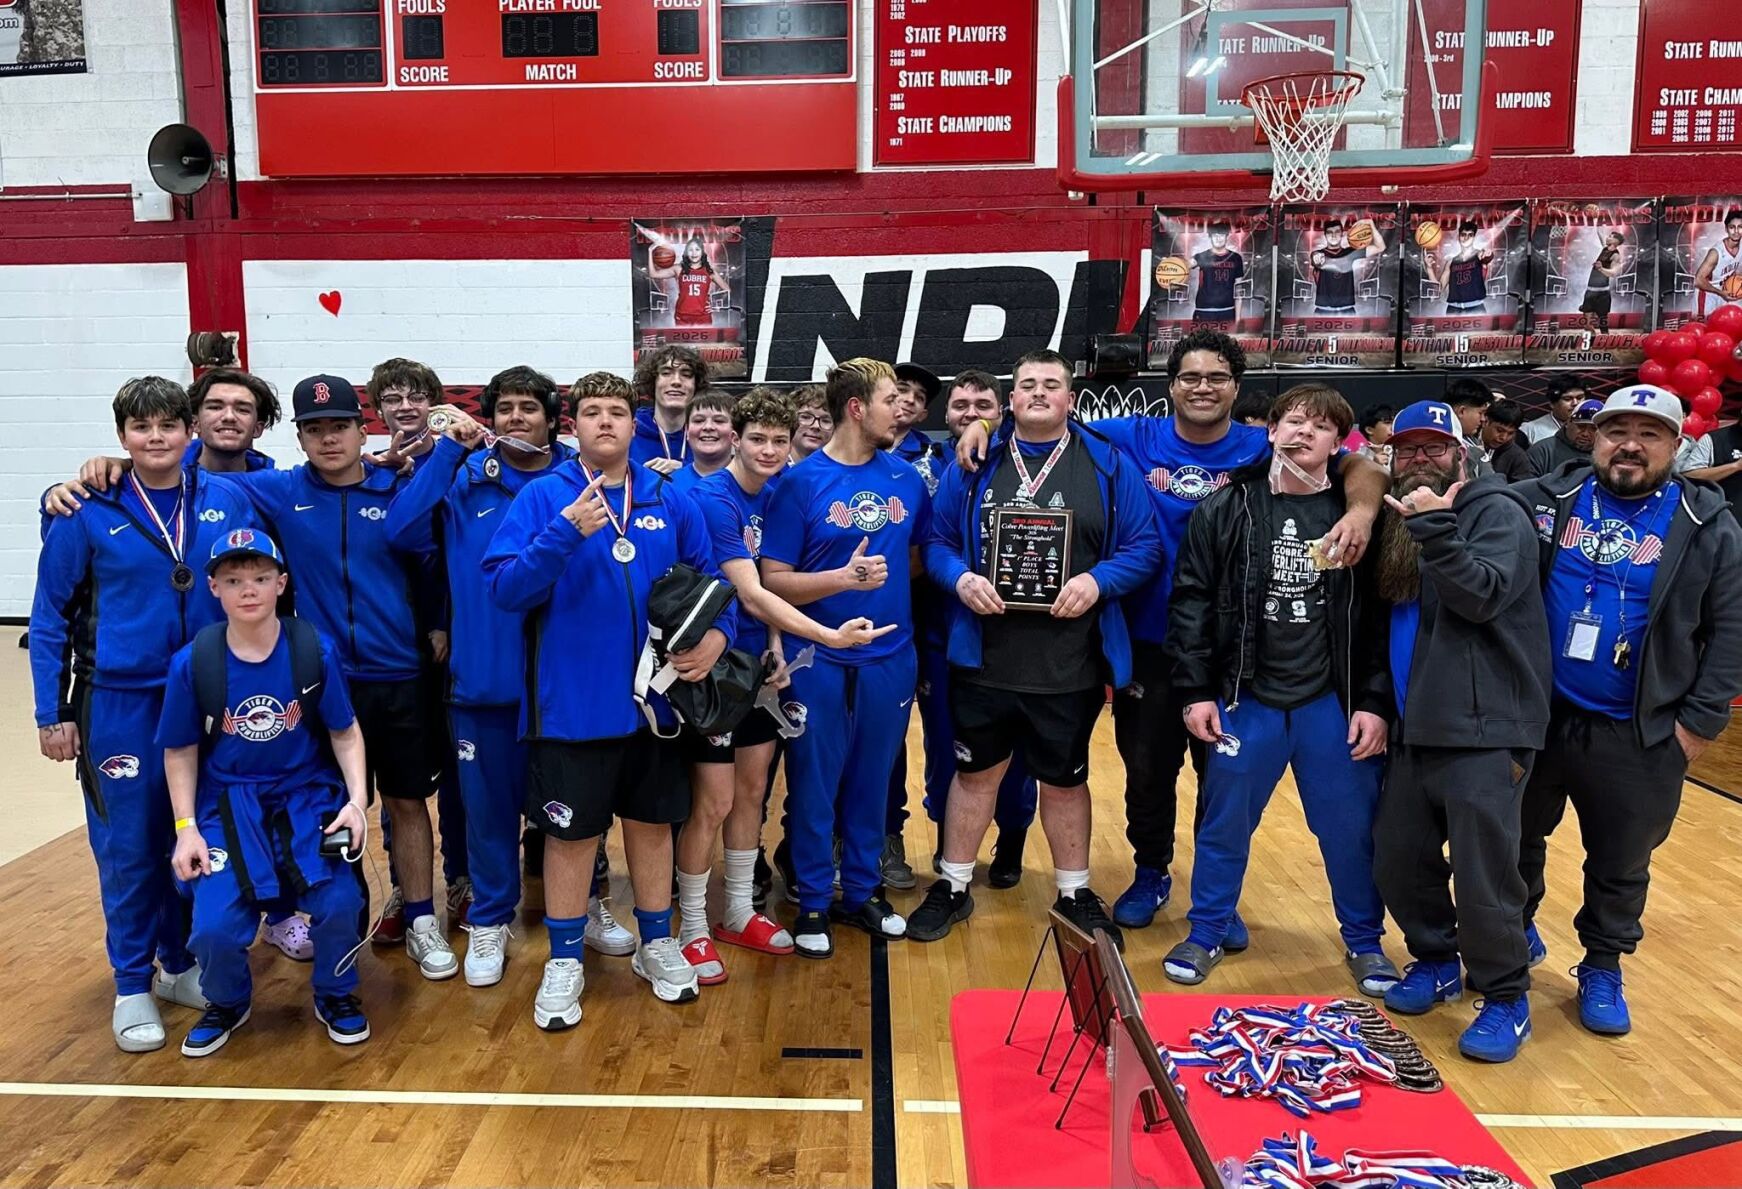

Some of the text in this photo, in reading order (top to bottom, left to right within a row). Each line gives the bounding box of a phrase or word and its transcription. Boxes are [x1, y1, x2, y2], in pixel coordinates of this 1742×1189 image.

[905, 24, 1007, 44] STATE PLAYOFFS
[1435, 30, 1467, 49] STAT
[1218, 38, 1246, 54] TATE
[1664, 40, 1704, 59] STATE
[400, 66, 449, 83] SCORE
[525, 63, 577, 81] MATCH
[653, 61, 704, 79] SCORE
[898, 67, 1013, 88] STATE RUNNER-UP
[1660, 87, 1699, 106] STATE
[898, 115, 1012, 134] STATE CHAMPIONS
[688, 284, 701, 297] 15
[1314, 320, 1353, 330] 2026
[1442, 319, 1482, 329] 2026
[1567, 317, 1608, 328] 2026
[672, 331, 709, 341] 2026
[1328, 335, 1338, 354] 5
[1454, 334, 1469, 353] 15
[1581, 331, 1592, 351] 3
[1306, 356, 1359, 365] SENIOR
[1436, 355, 1488, 364] SENIOR
[1558, 352, 1612, 362] SENIOR
[313, 382, 330, 404] B
[1630, 389, 1656, 407] T
[1428, 406, 1447, 425] T
[1181, 467, 1203, 476] TIGER
[855, 493, 876, 503] TIGER
[1273, 545, 1303, 558] COBRE
[1272, 554, 1314, 572] ERLIFTIN
[1272, 569, 1301, 583] MEET
[244, 698, 273, 709] TIGER
[238, 719, 283, 739] POWERLIFTING
